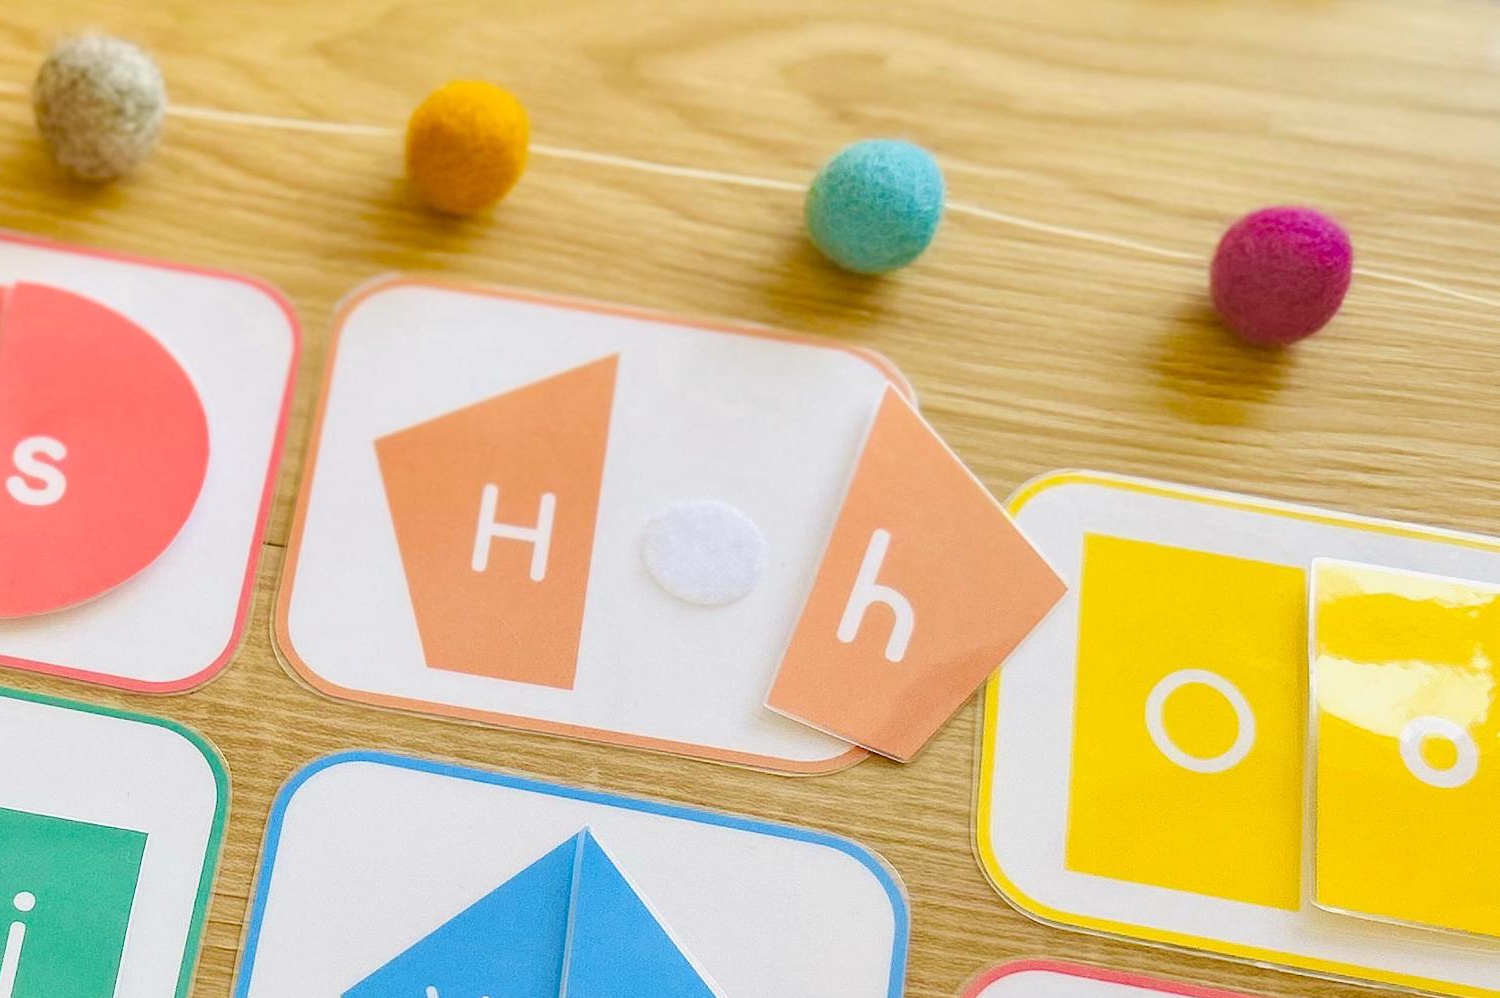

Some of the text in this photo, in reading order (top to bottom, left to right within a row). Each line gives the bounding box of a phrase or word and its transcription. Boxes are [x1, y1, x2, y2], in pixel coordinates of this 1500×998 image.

[5, 435, 67, 507] s
[471, 483, 916, 663] H h
[1144, 668, 1479, 789] O o
